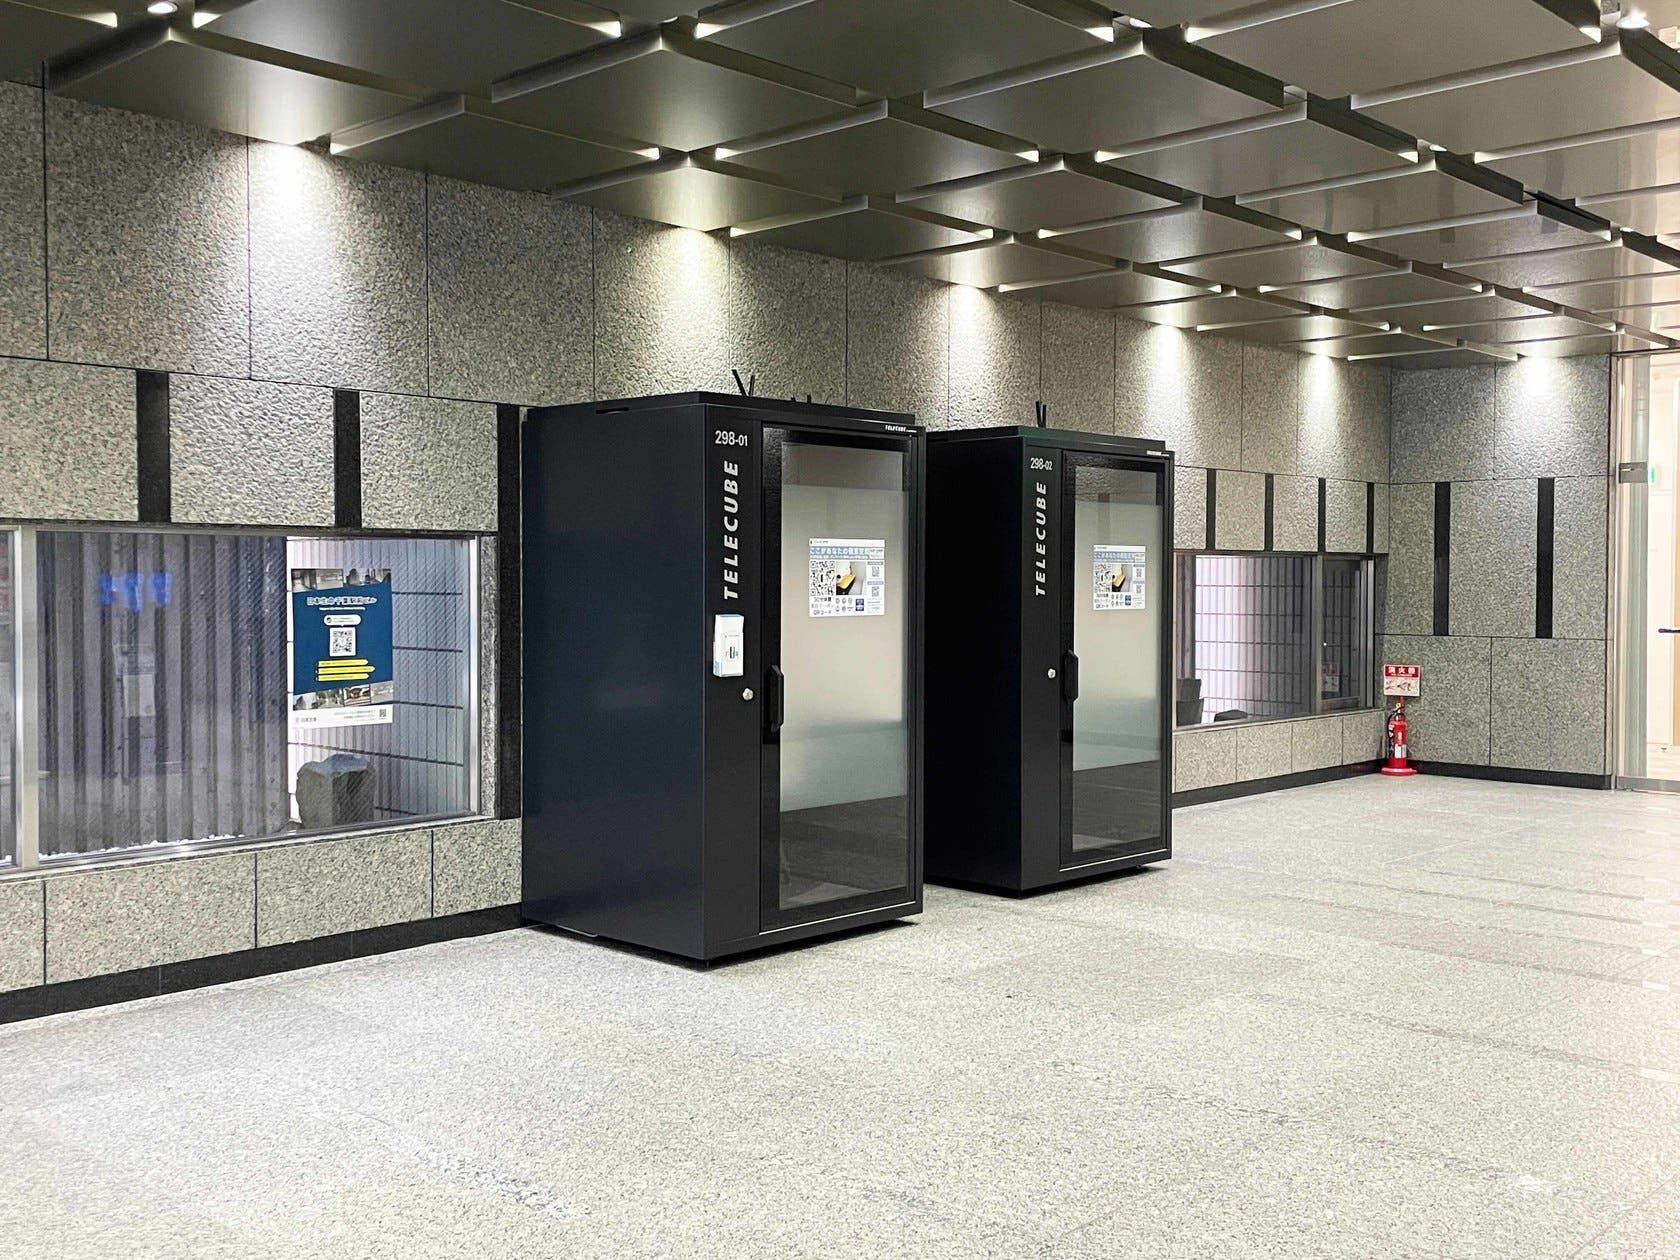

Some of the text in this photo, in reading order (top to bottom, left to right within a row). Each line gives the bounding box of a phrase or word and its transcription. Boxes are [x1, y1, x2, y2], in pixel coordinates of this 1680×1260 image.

[715, 430, 748, 447] 298-01
[1030, 457, 1053, 471] 298-02
[723, 460, 739, 600] TELECUBE
[1036, 482, 1047, 597] TELECUBE
[1388, 666, 1416, 674] 消火器
